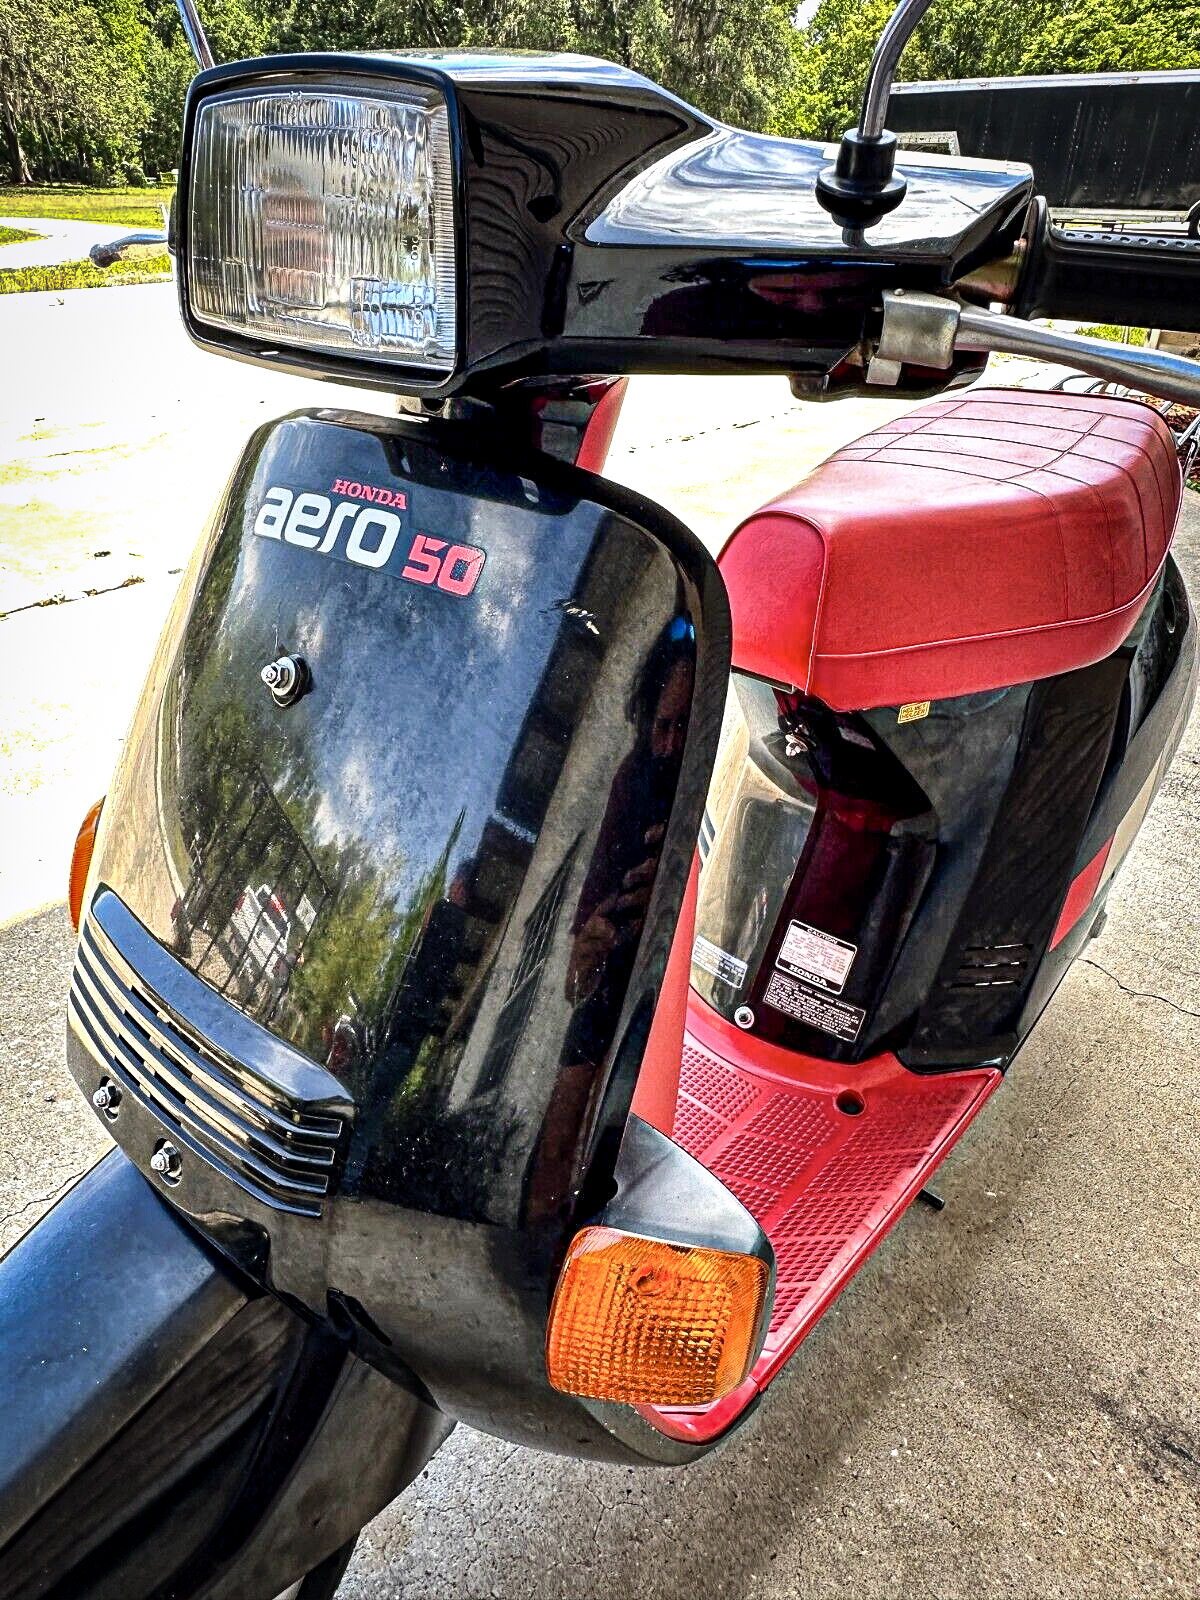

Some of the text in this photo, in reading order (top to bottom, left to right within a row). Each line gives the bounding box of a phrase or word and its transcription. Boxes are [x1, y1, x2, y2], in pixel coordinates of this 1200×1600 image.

[332, 478, 408, 510] HONDA
[254, 487, 485, 596] aero 50
[806, 928, 838, 944] CAUTION
[789, 965, 828, 987] HONDA
